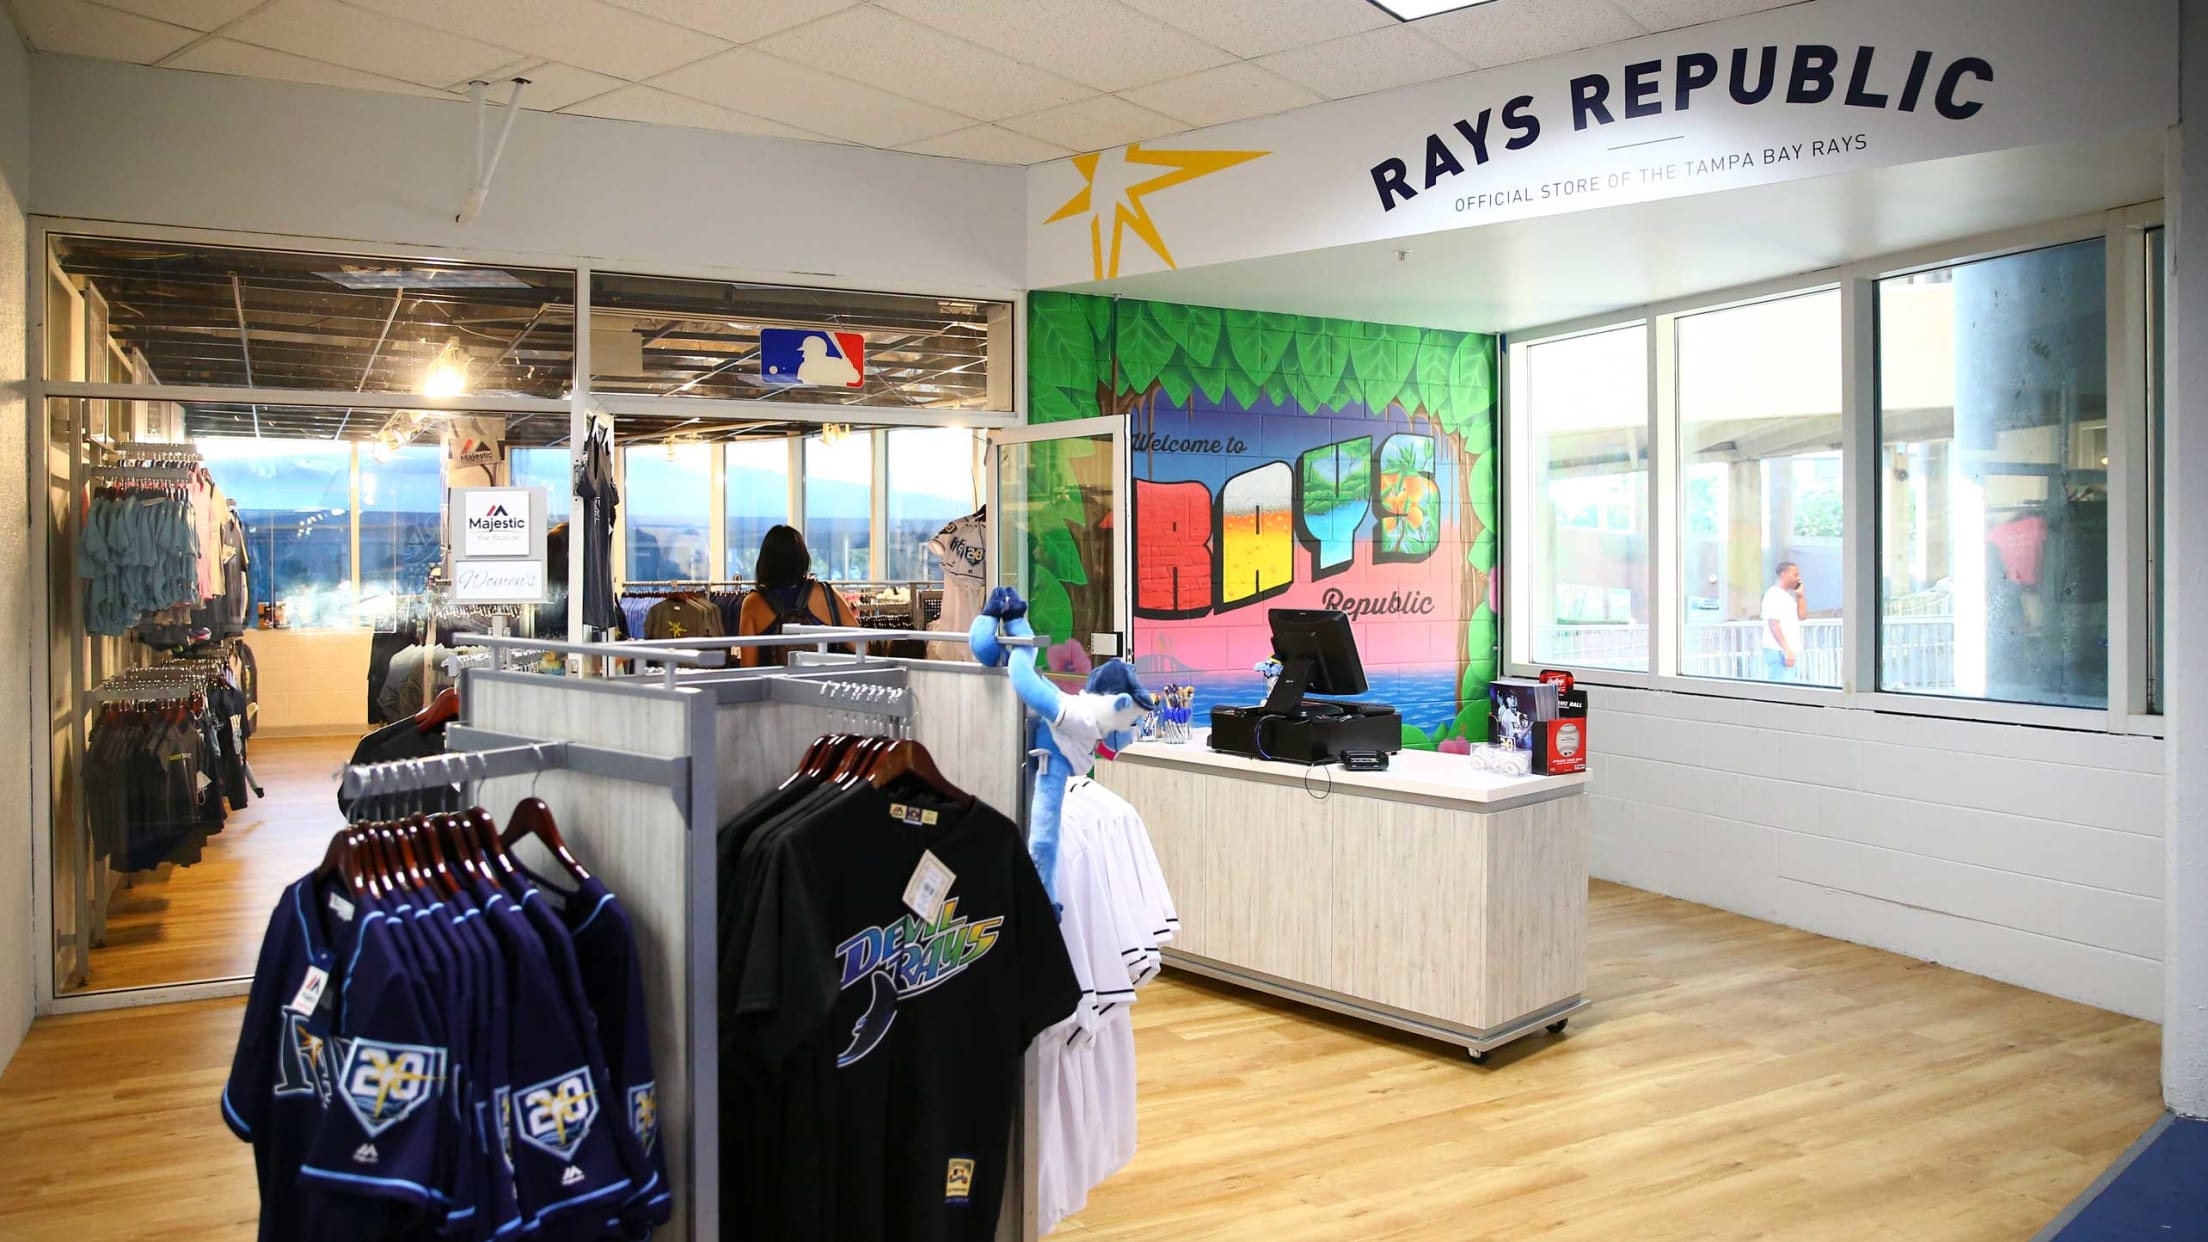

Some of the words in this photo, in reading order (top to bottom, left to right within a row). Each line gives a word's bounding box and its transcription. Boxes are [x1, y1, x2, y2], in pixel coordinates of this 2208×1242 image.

[1370, 94, 1541, 212] RAYS
[1570, 44, 1994, 131] REPUBLIC
[1455, 187, 1534, 213] OFFICIAL
[1541, 175, 1601, 200] STORE
[1608, 172, 1631, 190] OF
[1639, 164, 1677, 186] THE
[1684, 151, 1755, 177] TAMPA
[1763, 143, 1803, 166] BAY
[1811, 133, 1868, 158] RAYS
[1131, 431, 1224, 454] Welcome
[1226, 435, 1248, 454] to
[469, 517, 525, 533] Majestic
[1132, 432, 1442, 621] RAYS
[458, 569, 536, 590] Women's
[1322, 587, 1435, 622] Republic
[880, 915, 1005, 988] RAYS
